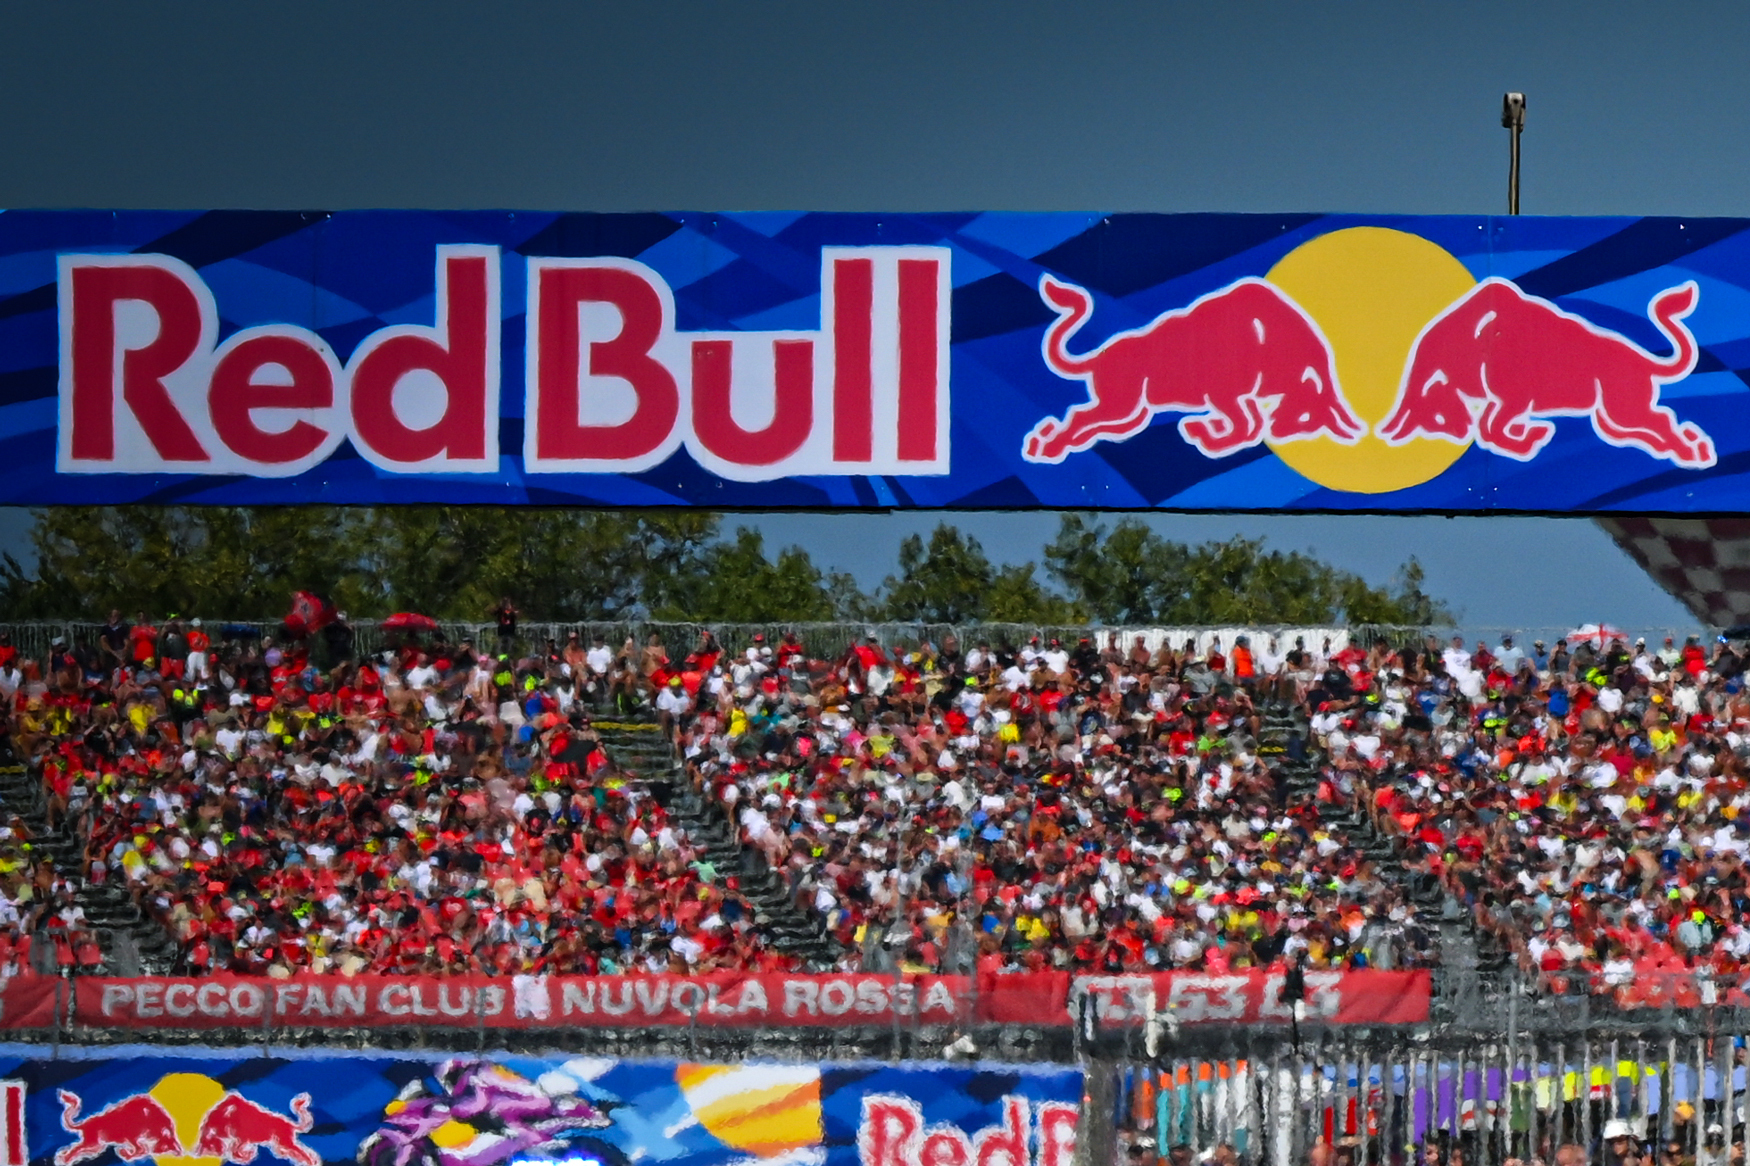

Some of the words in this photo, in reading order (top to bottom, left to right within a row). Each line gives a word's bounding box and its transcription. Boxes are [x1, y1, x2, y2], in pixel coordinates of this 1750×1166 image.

[62, 250, 495, 470] Red
[530, 251, 946, 472] Bull
[102, 982, 265, 1017] PECCO
[275, 984, 366, 1016] FAN
[377, 983, 504, 1016] CLUB
[562, 979, 770, 1016] NUVOLA
[782, 979, 955, 1017] ROSSA
